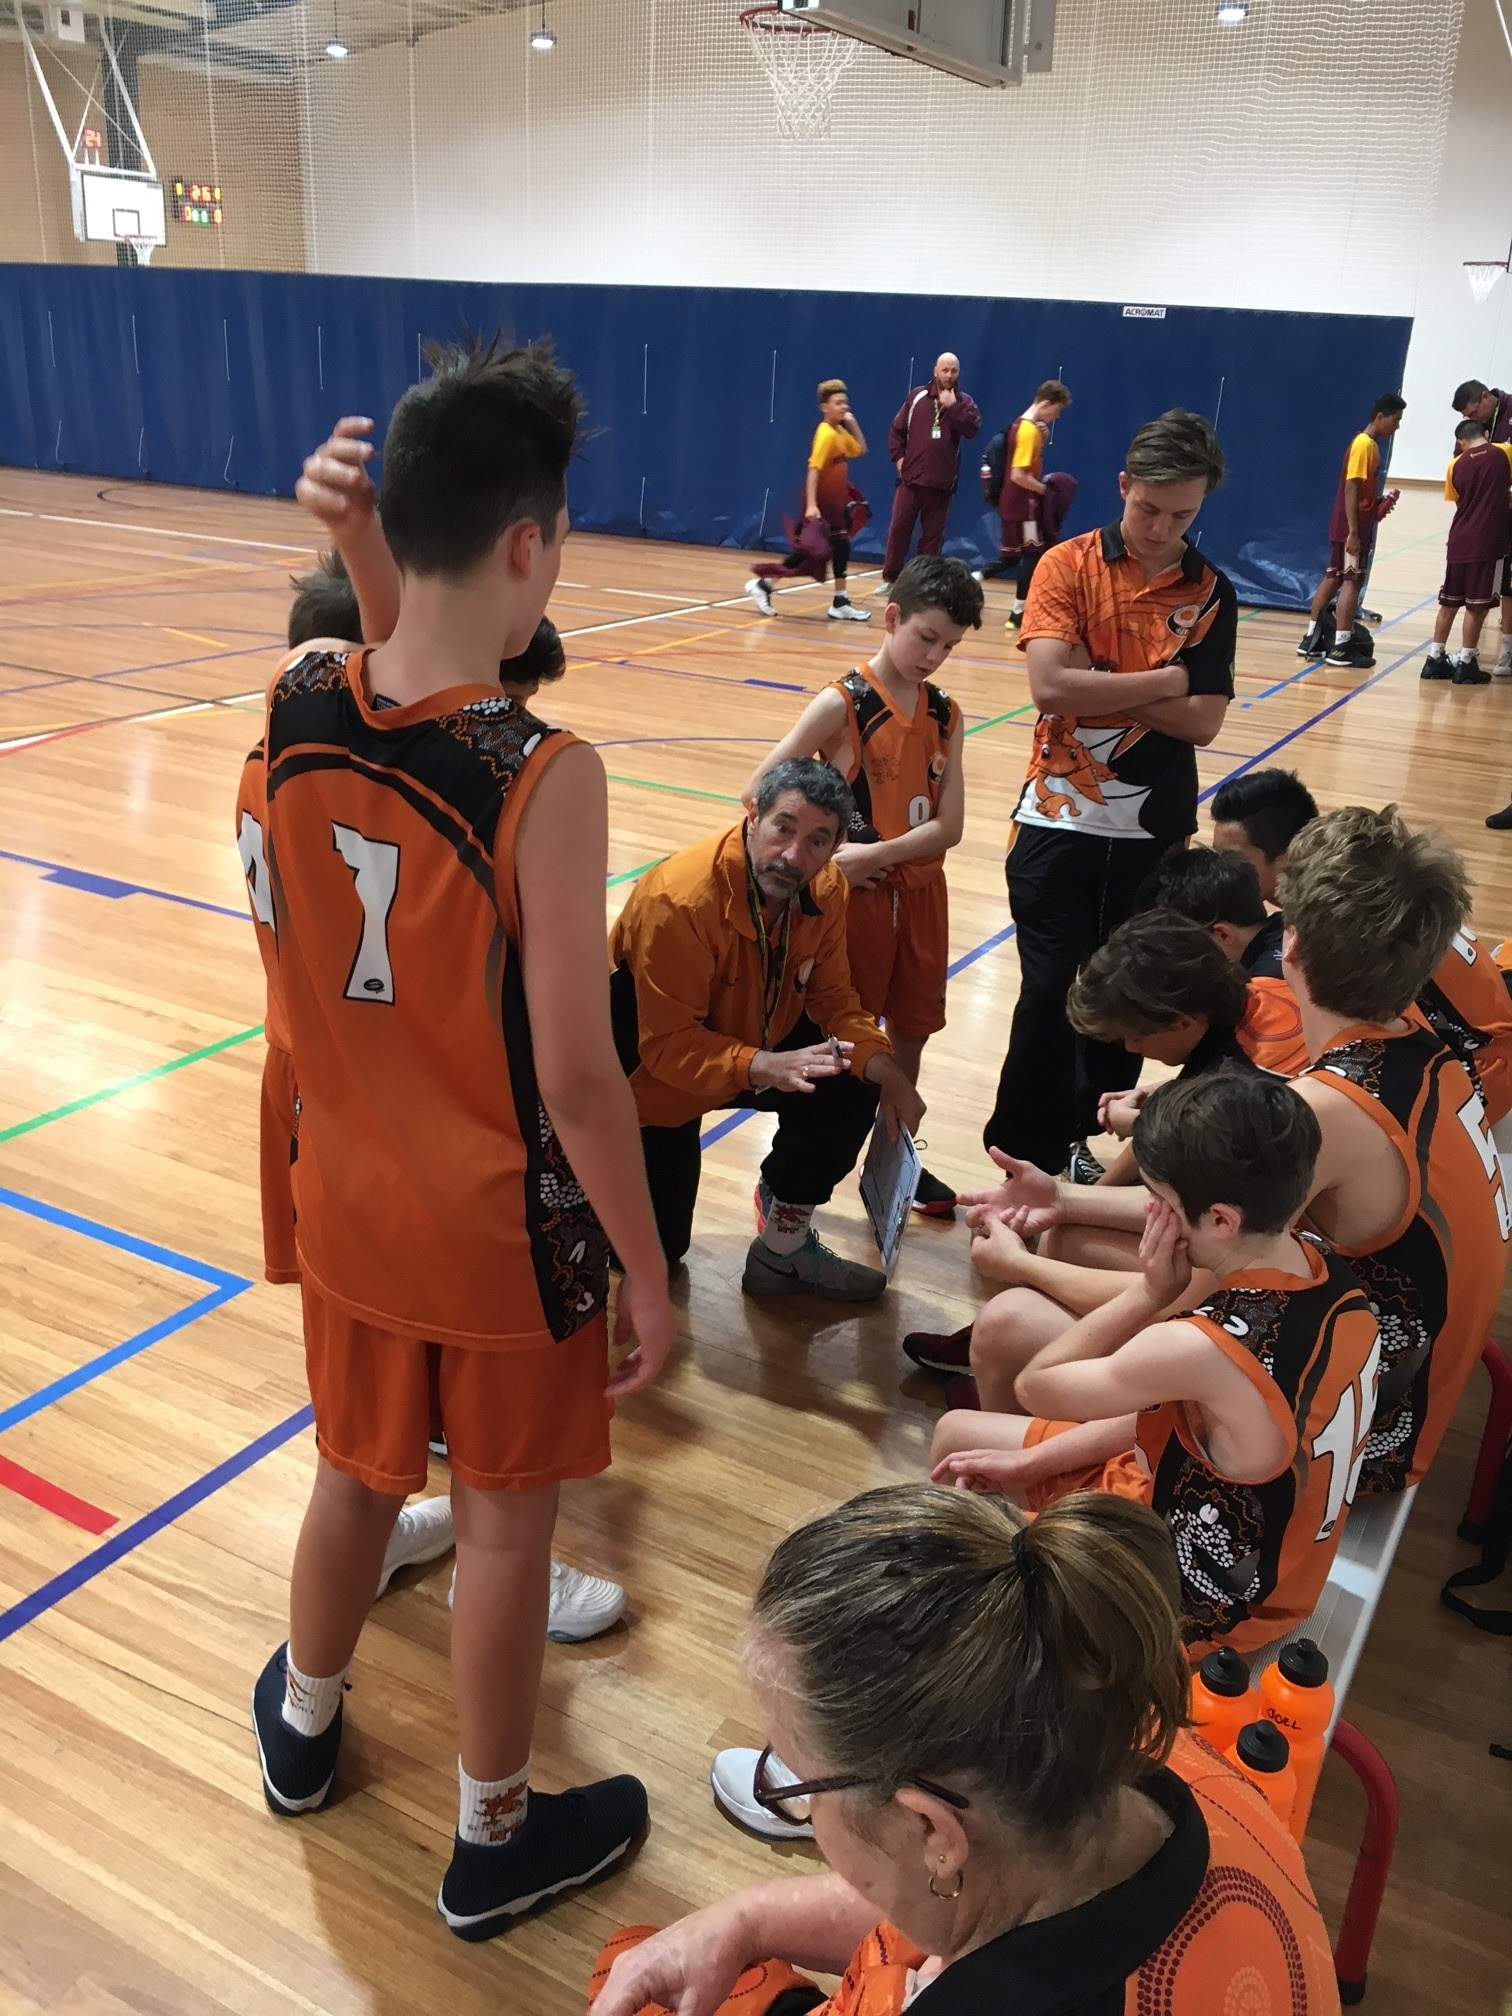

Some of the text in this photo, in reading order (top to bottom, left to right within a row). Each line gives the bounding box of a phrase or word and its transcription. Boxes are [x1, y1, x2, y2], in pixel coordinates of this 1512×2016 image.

[1125, 307, 1164, 318] ACROMAT
[331, 819, 400, 1005] 7
[1266, 1708, 1302, 1730] JOEL
